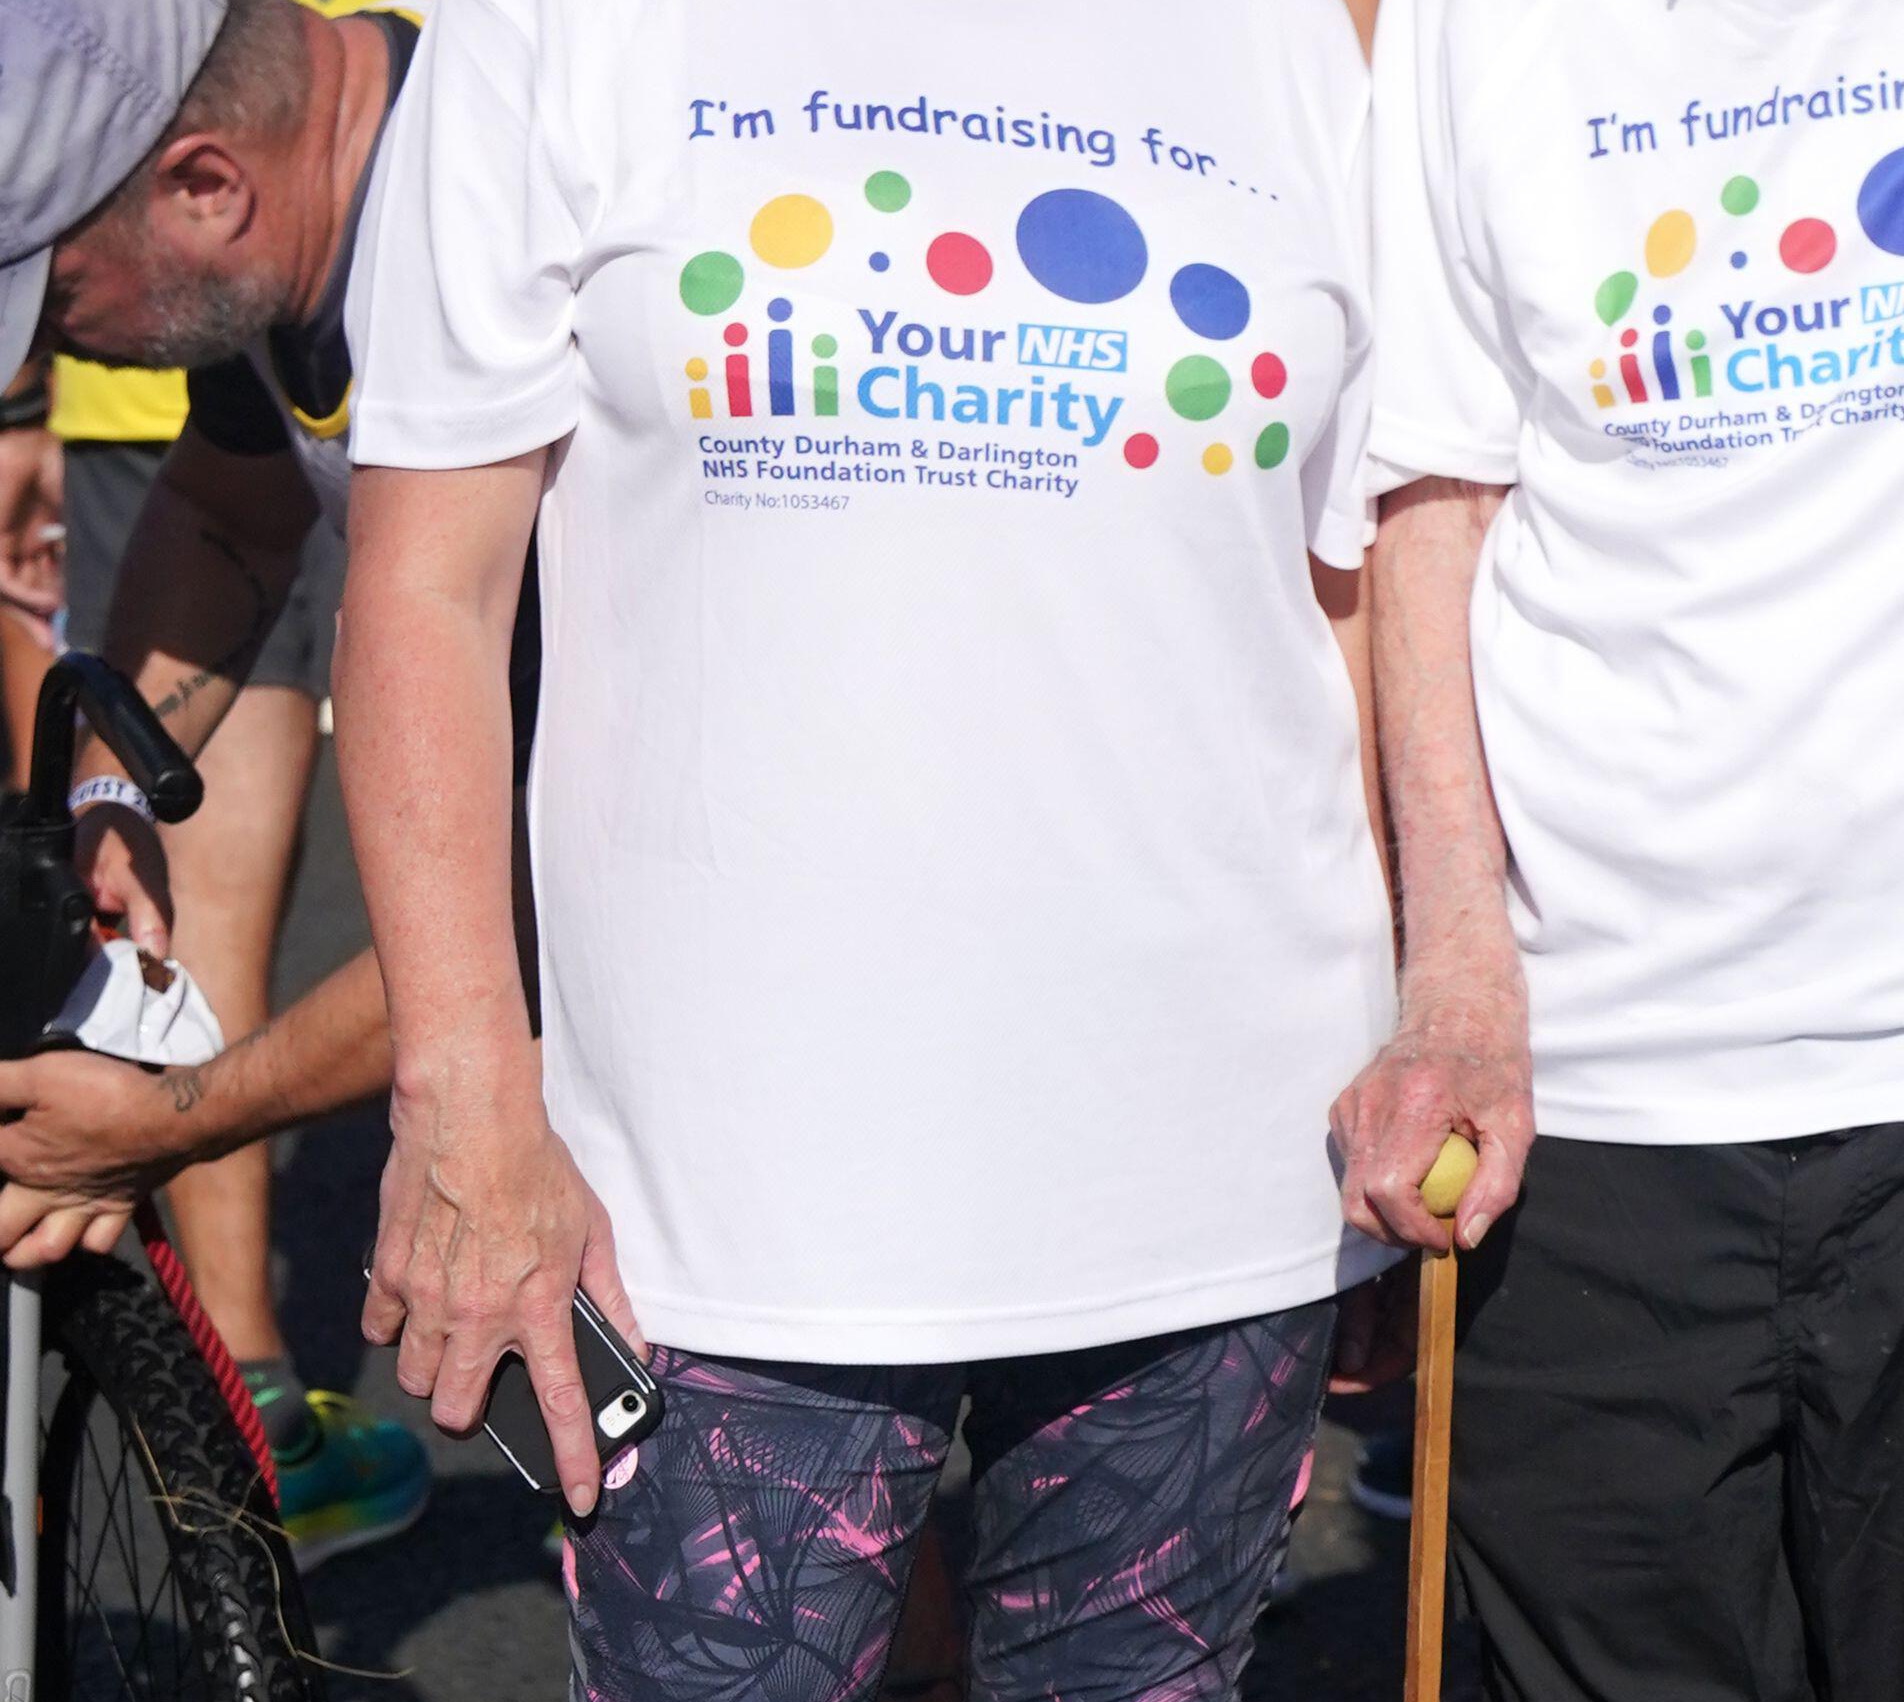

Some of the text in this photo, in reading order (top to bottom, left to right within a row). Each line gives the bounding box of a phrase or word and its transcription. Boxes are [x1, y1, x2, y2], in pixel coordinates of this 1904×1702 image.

[688, 98, 776, 141] I'm
[802, 90, 1117, 168] fundraising
[1586, 113, 1658, 159] I'm
[1719, 294, 1851, 340] Your
[857, 308, 1125, 371] Your NHS
[856, 364, 1125, 448] Charity
[1604, 414, 1672, 439] County
[1678, 408, 1768, 432] Durham
[1776, 403, 1793, 422] &
[699, 434, 1079, 472] County Durham & Darlington
[703, 458, 1080, 499] NHS Foundation Trust Charity
[704, 490, 751, 511] Charity
[70, 780, 126, 807] UEST
